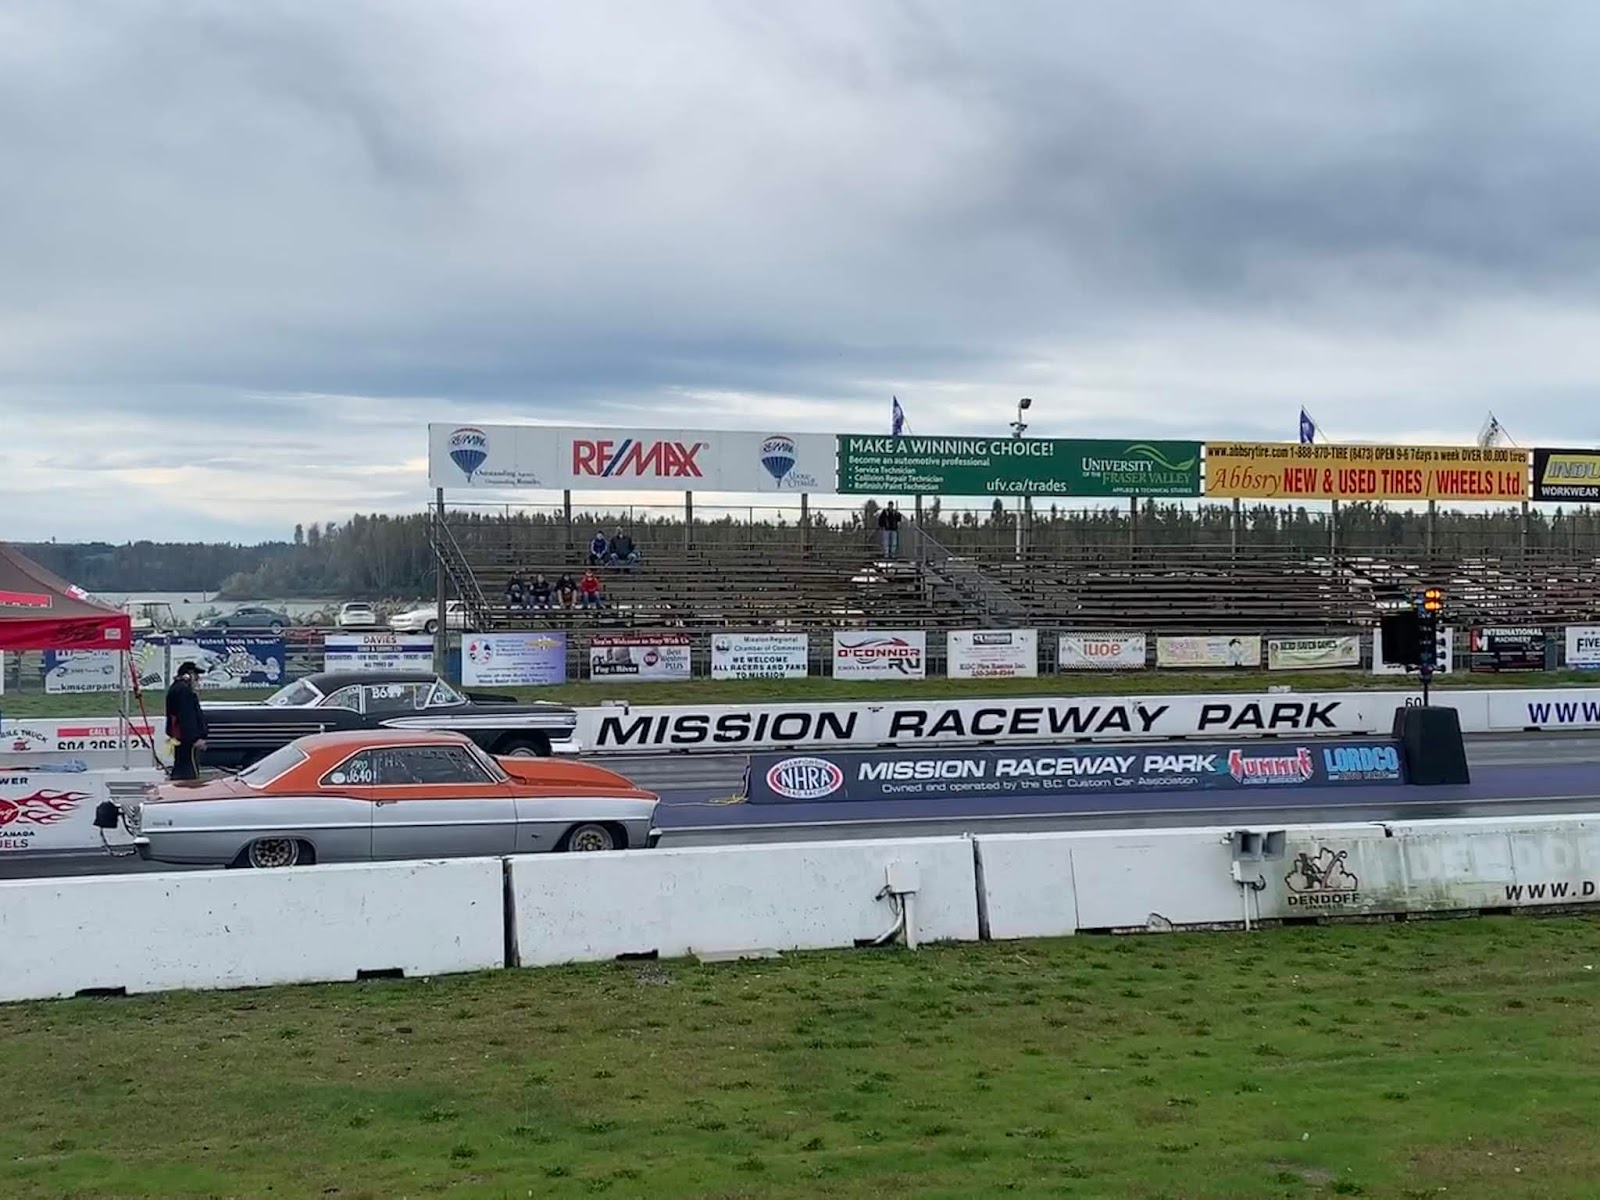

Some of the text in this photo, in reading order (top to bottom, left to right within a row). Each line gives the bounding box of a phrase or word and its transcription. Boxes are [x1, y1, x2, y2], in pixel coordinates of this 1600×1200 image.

[850, 439, 1054, 456] MAKE A WINNING CHOICE!
[573, 439, 703, 477] RE/MAX
[849, 456, 881, 465] Become
[894, 457, 940, 466] automotive
[941, 457, 990, 467] professional
[1375, 448, 1395, 460] OPEN
[1434, 451, 1439, 460] a
[1440, 449, 1459, 461] week
[1461, 449, 1481, 461] OVER
[1510, 451, 1527, 463] tires
[855, 466, 917, 474] Service Technician
[1082, 457, 1154, 472] UNIVERSITY
[854, 474, 885, 482] Collision
[909, 475, 944, 483] Technician
[986, 478, 1067, 492] ufv.ca/trades
[1103, 471, 1147, 485] FRASER
[1149, 472, 1192, 485] VALLEY
[1207, 466, 1525, 497] Abbsry NEW & USED TIRES / WHEELS Ltd.
[903, 483, 939, 491] Technician
[1541, 486, 1599, 498] WORKWEAR
[1482, 628, 1543, 637] INTERNATIONAL
[363, 636, 398, 645] DAVIES
[1494, 636, 1532, 645] MACHINERY
[736, 672, 747, 680] TO
[1405, 697, 1422, 707] 60
[597, 702, 1342, 745] MISSION RACEWAY PARK
[1323, 747, 1399, 772] LORDCO
[858, 754, 1217, 780] MISSION RACEWAY PARK
[781, 766, 830, 790] NHRA
[882, 783, 922, 793] Owned
[926, 783, 946, 791] and
[950, 781, 1000, 793] operated
[1003, 780, 1017, 790] by
[1021, 780, 1040, 789] the
[1067, 778, 1112, 788] Custom
[1114, 777, 1134, 786] Car
[1138, 776, 1198, 785] Association
[1288, 893, 1360, 905] DENDOFF
